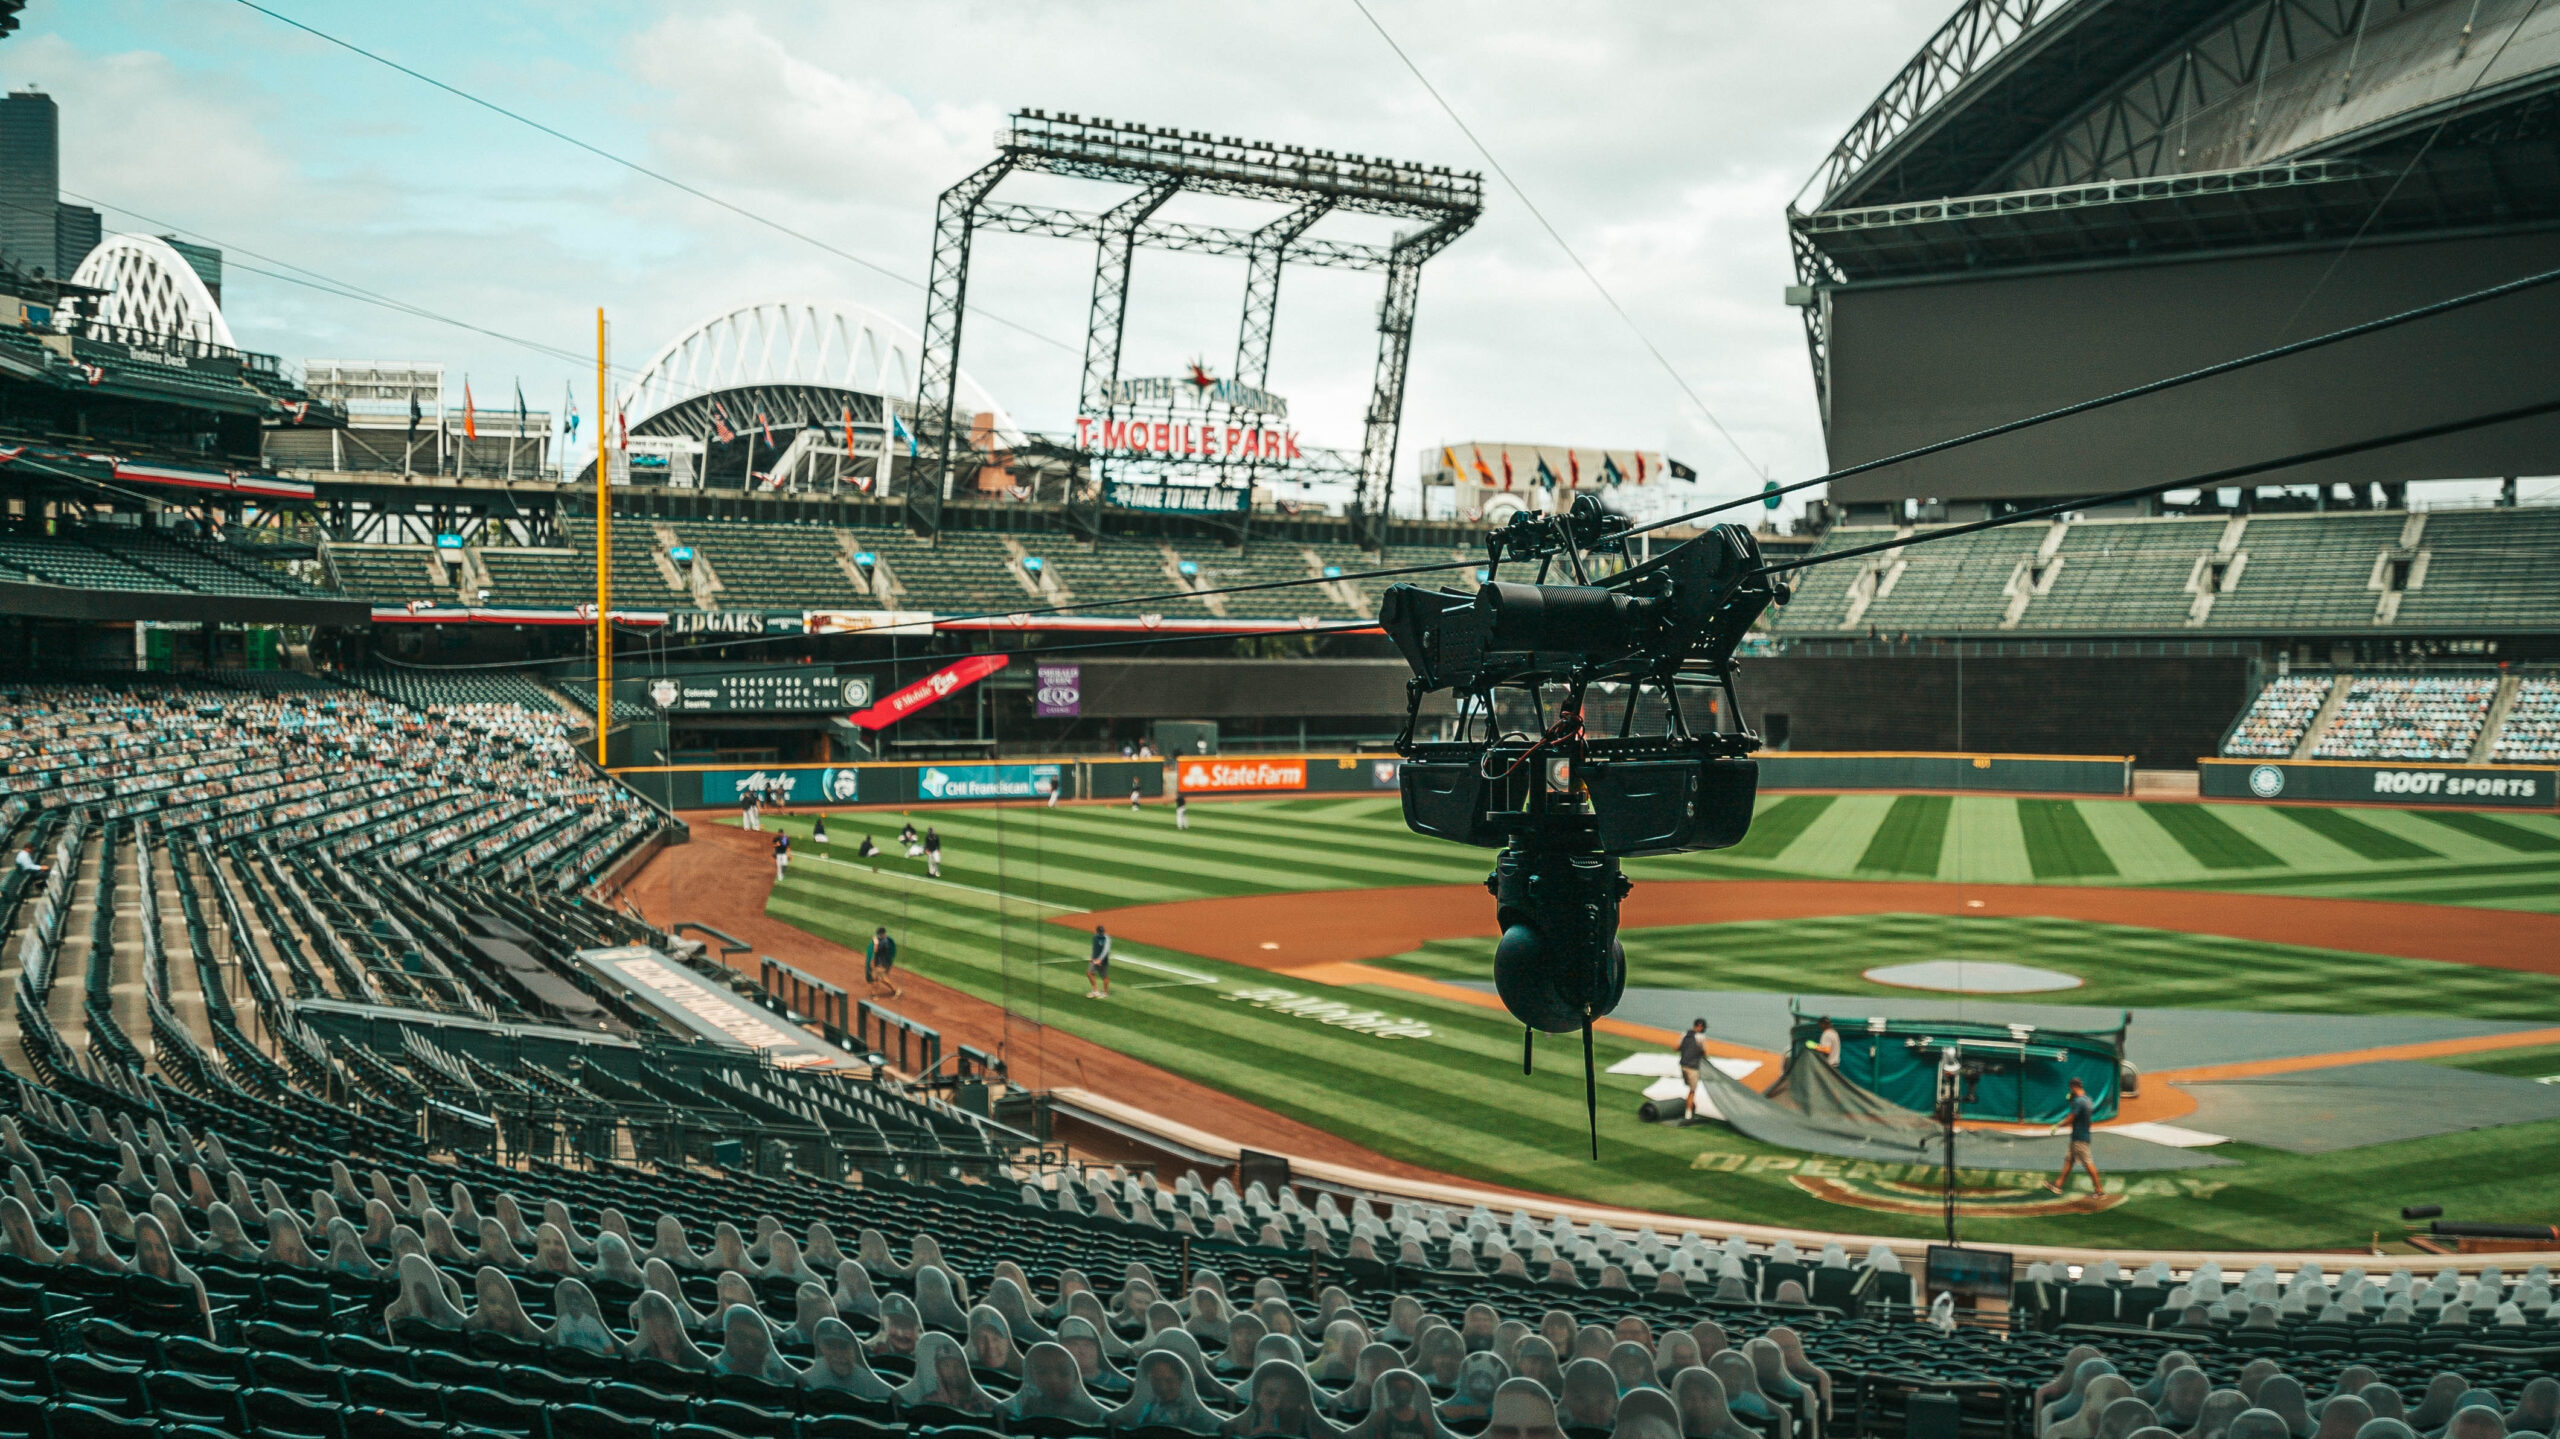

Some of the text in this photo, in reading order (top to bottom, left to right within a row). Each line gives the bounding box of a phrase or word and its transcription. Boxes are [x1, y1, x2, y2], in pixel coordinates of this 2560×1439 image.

[163, 352, 188, 368] Deck
[1076, 419, 1301, 459] T-MOBILE PARK
[676, 612, 763, 633] EDGARS
[2374, 771, 2536, 797] ROOT SPORTS
